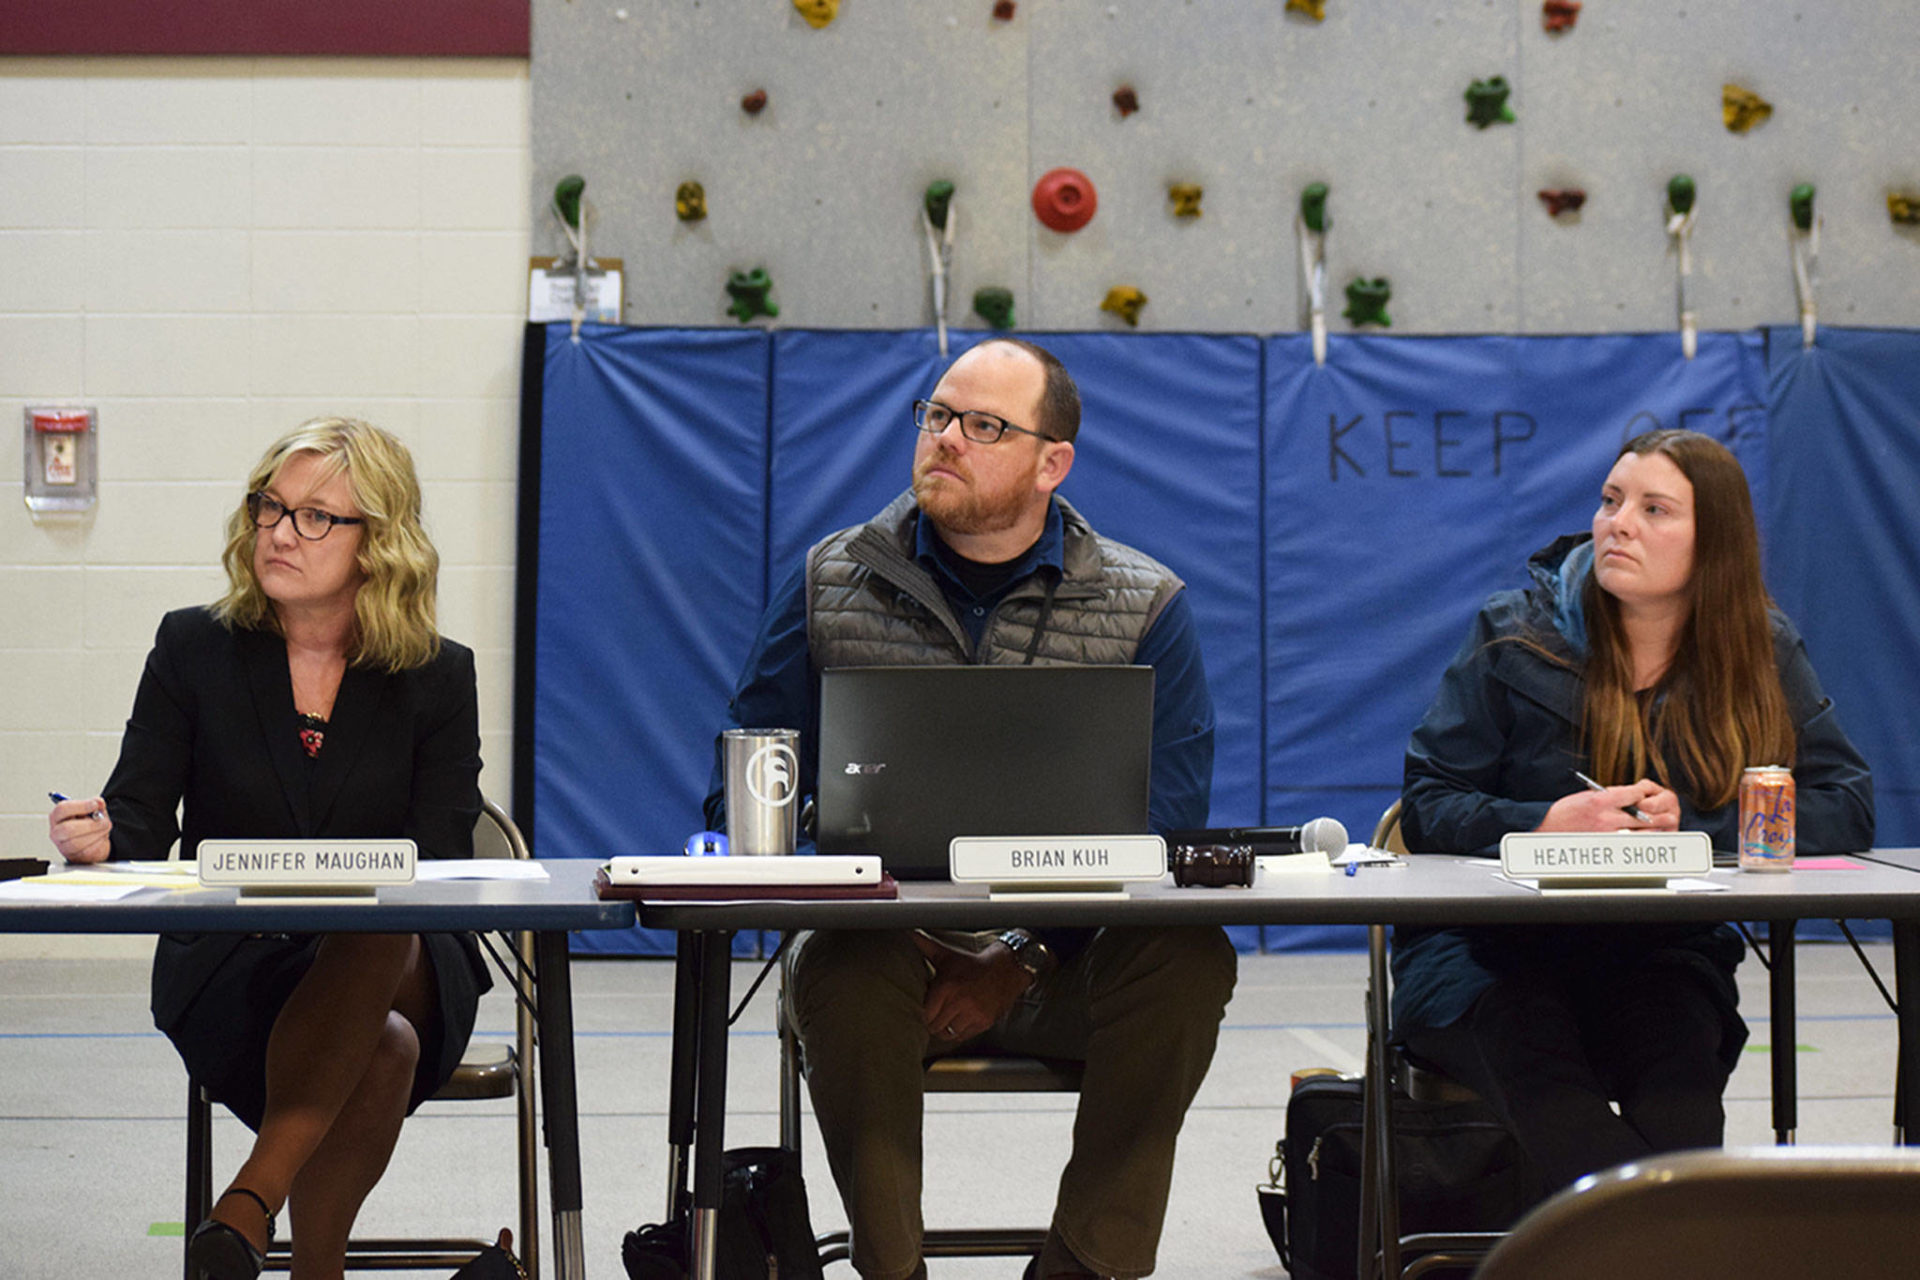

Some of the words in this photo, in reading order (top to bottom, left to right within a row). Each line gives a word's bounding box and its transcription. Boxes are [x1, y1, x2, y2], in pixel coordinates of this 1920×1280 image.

[1329, 409, 1537, 481] KEEP
[212, 852, 306, 871] JENNIFER
[315, 851, 405, 870] MAUGHAN
[1011, 849, 1066, 868] BRIAN
[1072, 848, 1110, 866] KUH
[1533, 847, 1615, 865] HEATHER
[1622, 845, 1678, 864] SHORT
